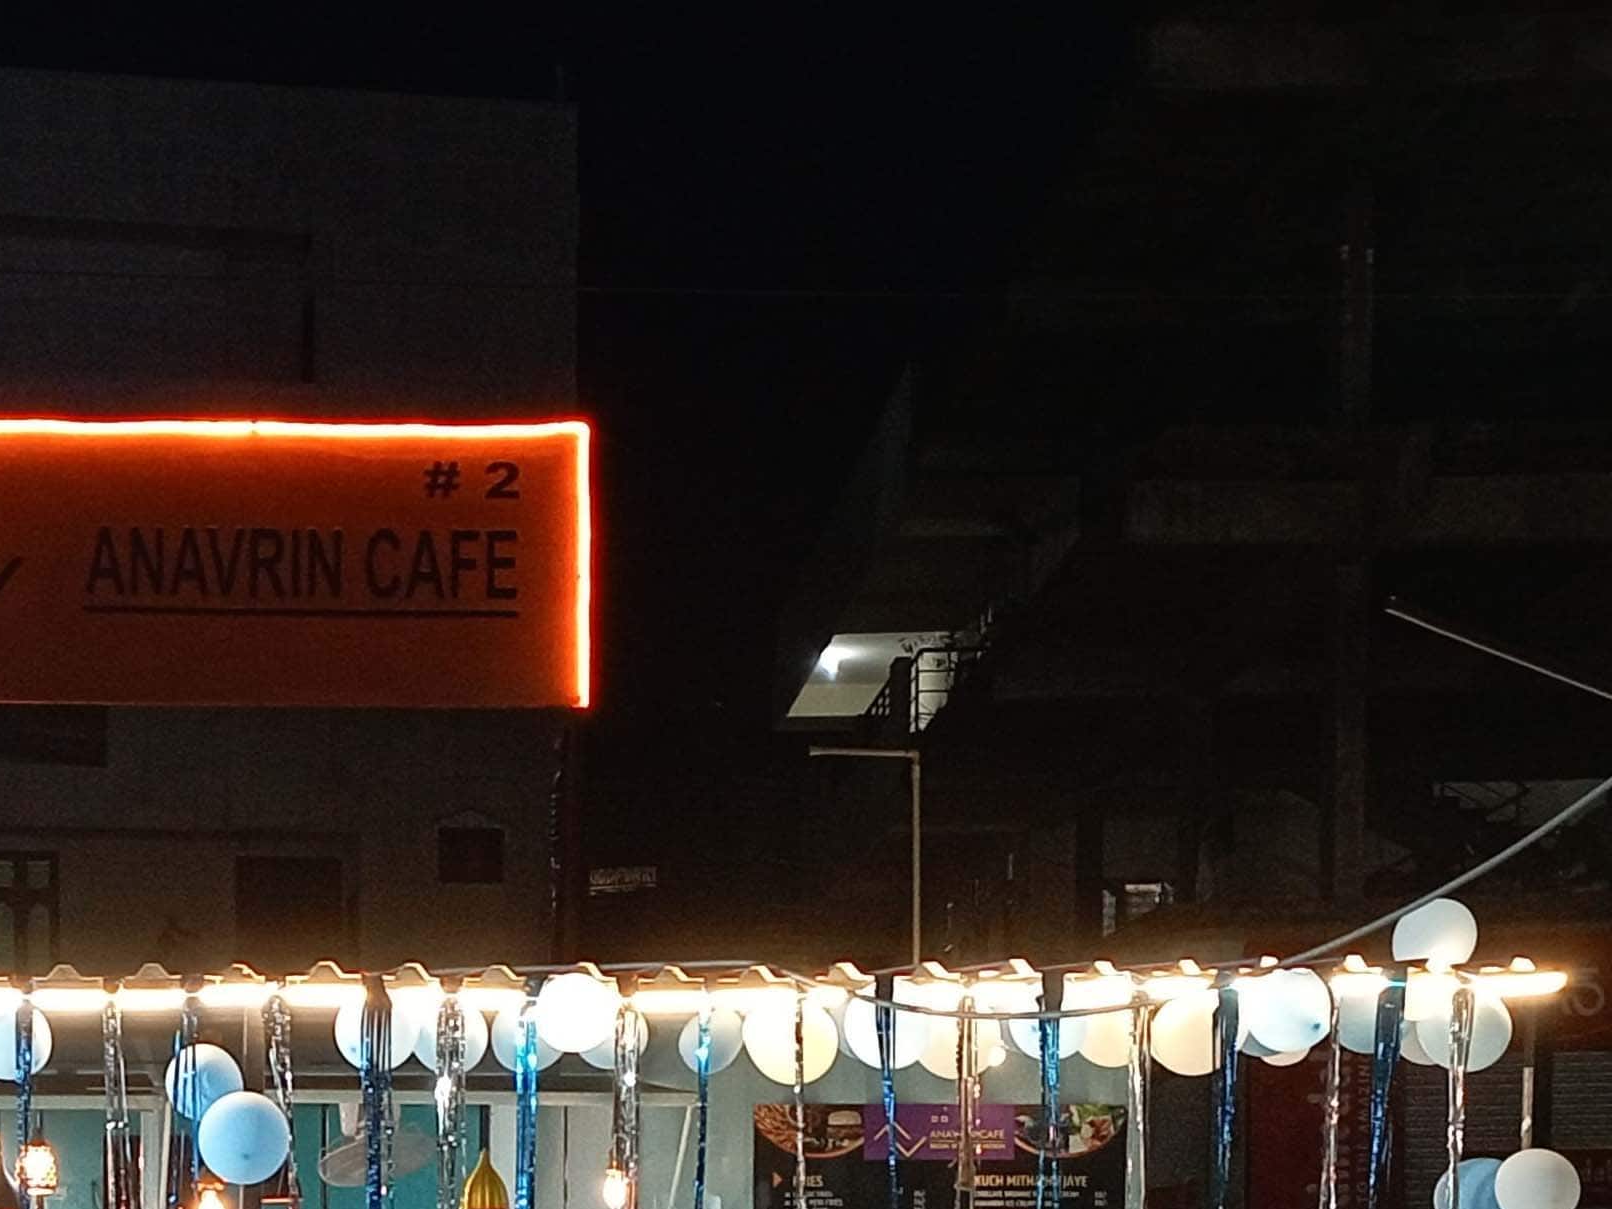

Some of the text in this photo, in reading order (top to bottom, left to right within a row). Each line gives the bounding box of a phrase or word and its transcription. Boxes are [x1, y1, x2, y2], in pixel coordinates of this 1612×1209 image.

[424, 461, 522, 500] # 2
[86, 527, 520, 602] ANAVRIN CAFE
